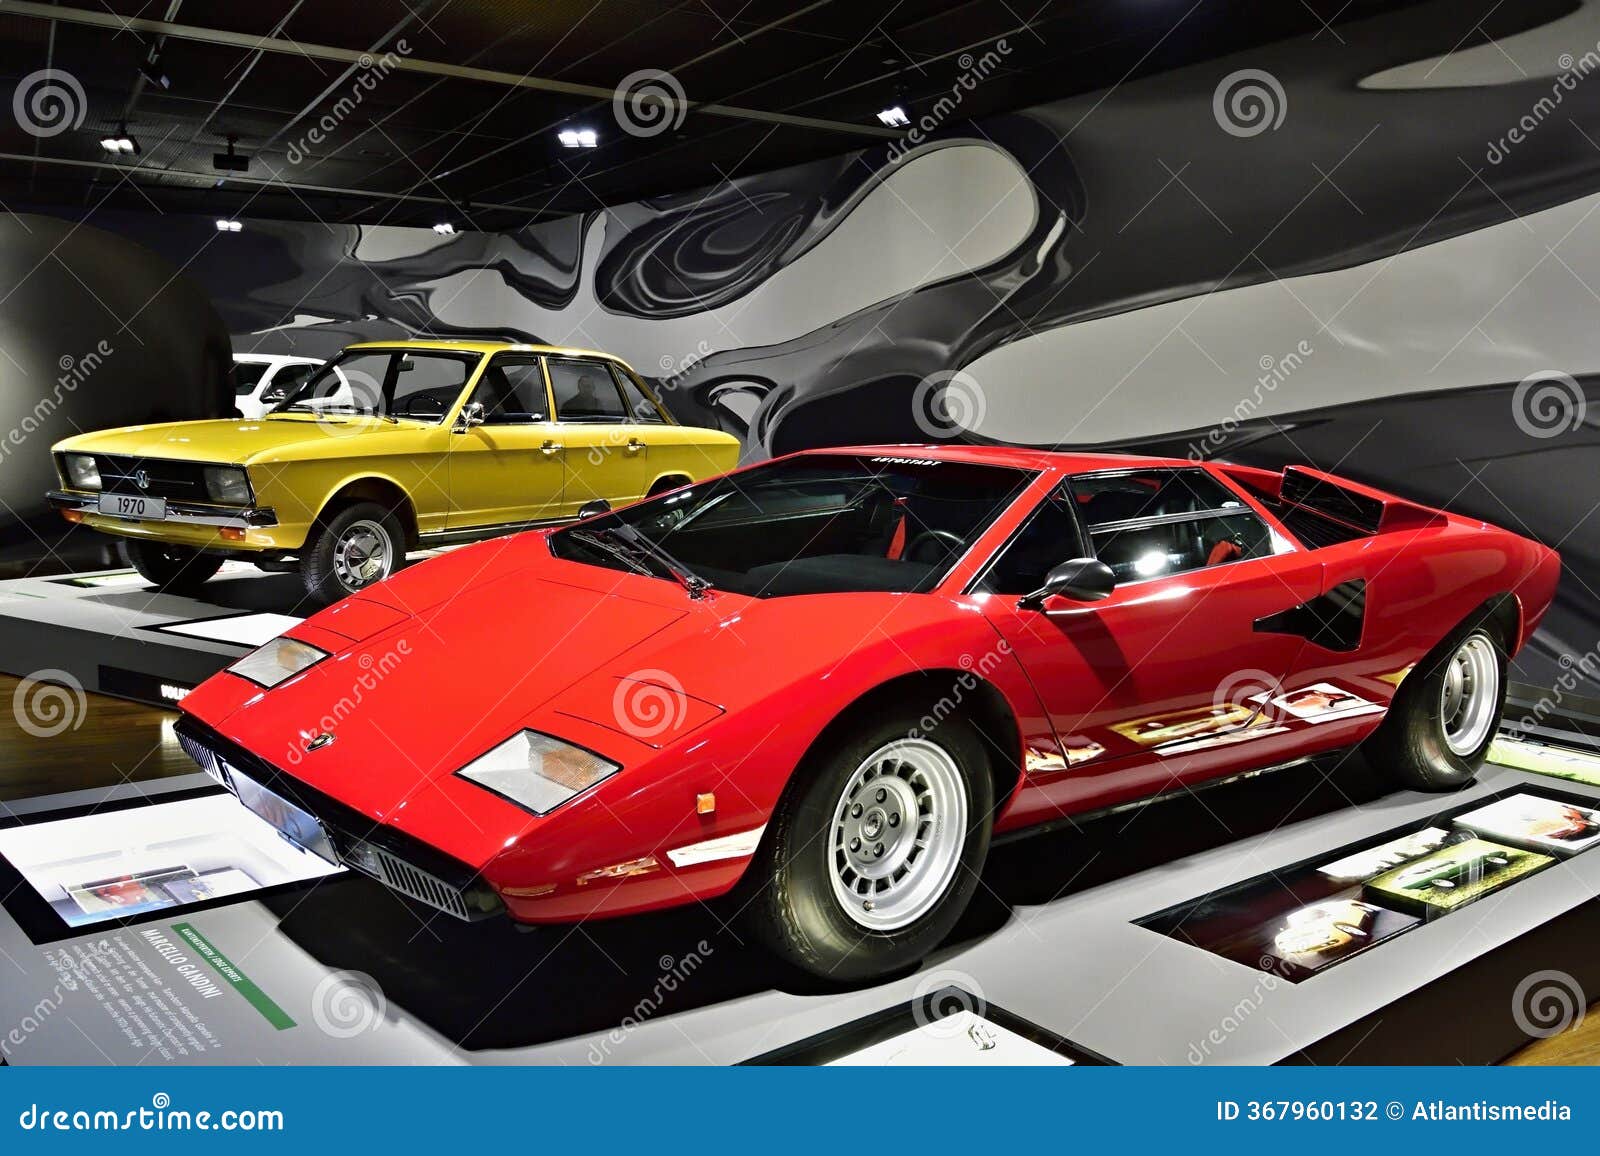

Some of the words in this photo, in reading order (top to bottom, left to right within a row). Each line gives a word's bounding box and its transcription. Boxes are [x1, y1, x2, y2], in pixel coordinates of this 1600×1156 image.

[118, 497, 145, 514] 1970
[140, 929, 187, 965] MARCELLO
[177, 964, 223, 999] GANDINI
